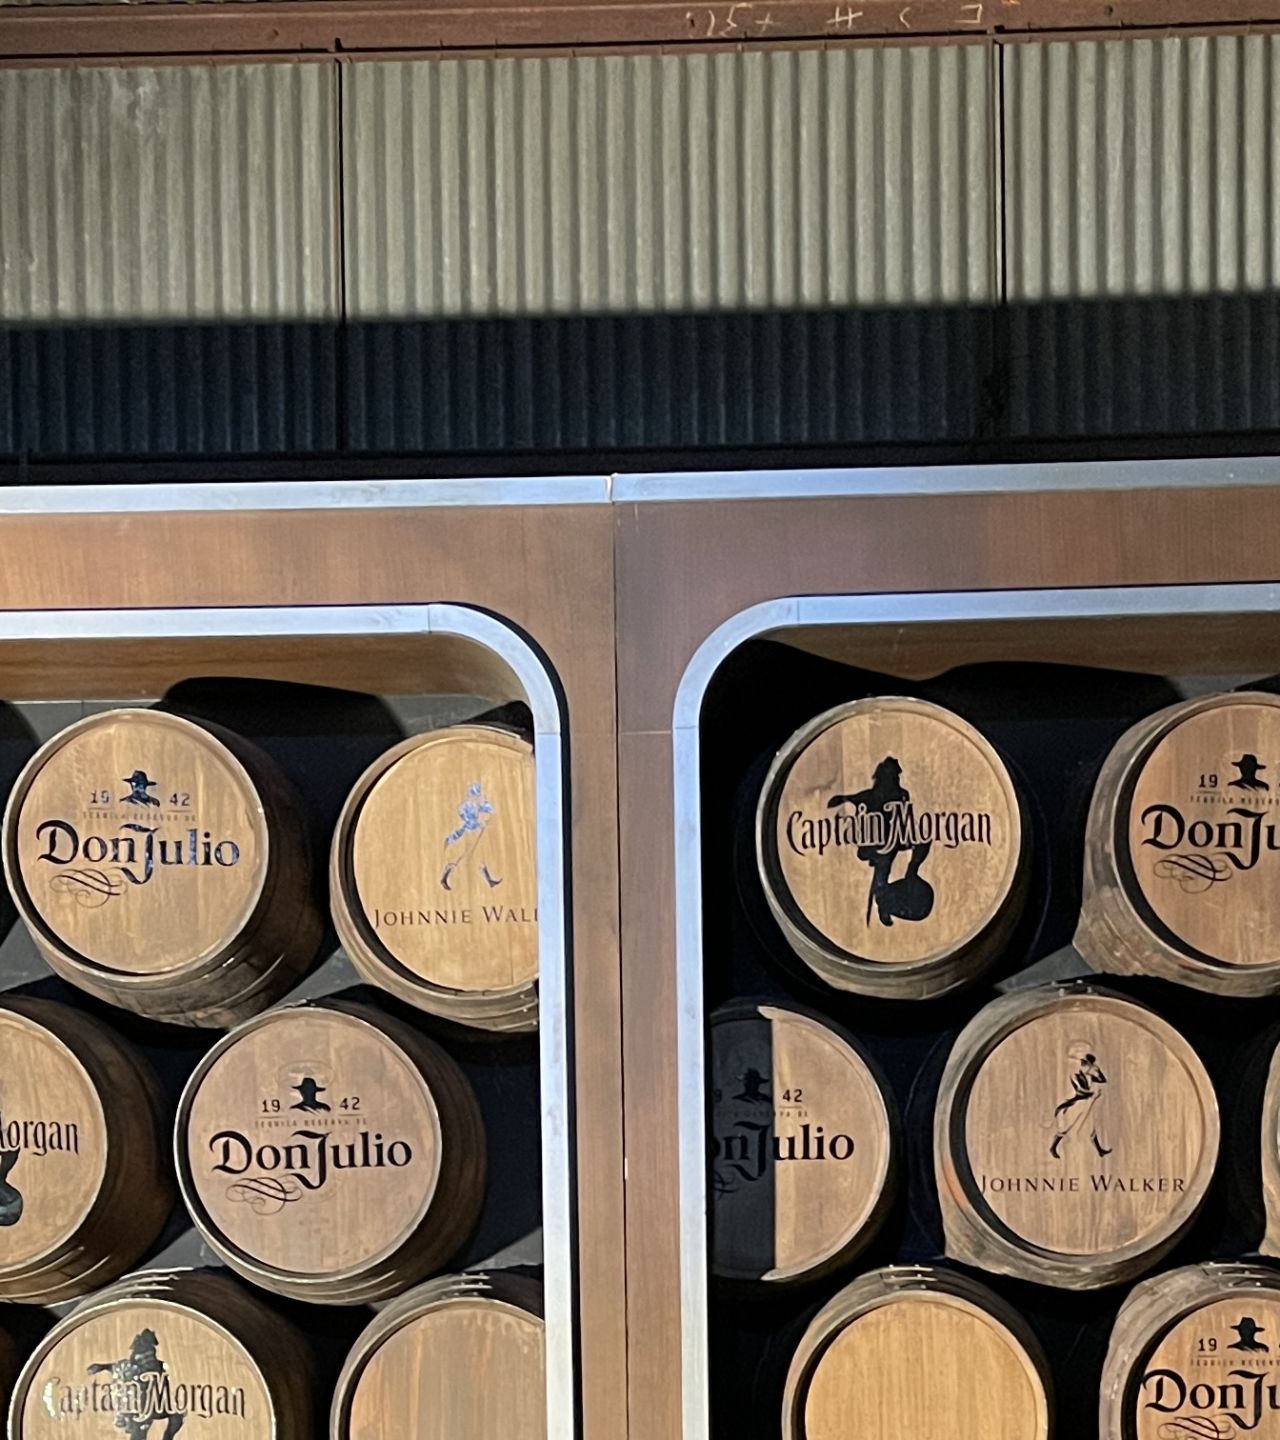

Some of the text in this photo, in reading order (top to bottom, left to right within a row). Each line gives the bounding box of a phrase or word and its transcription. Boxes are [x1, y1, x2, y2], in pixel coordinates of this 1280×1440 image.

[1198, 773, 1219, 789] 19
[90, 789, 191, 807] 19 42
[786, 800, 992, 857] Captain Morgan
[374, 908, 473, 929] JOHNNIE
[261, 1096, 361, 1113] 19 42
[782, 1088, 803, 1103] 42
[981, 1174, 1185, 1194] JOHNNIE WALKER
[1197, 1337, 1218, 1352] 19
[136, 1371, 246, 1423] Morgan
